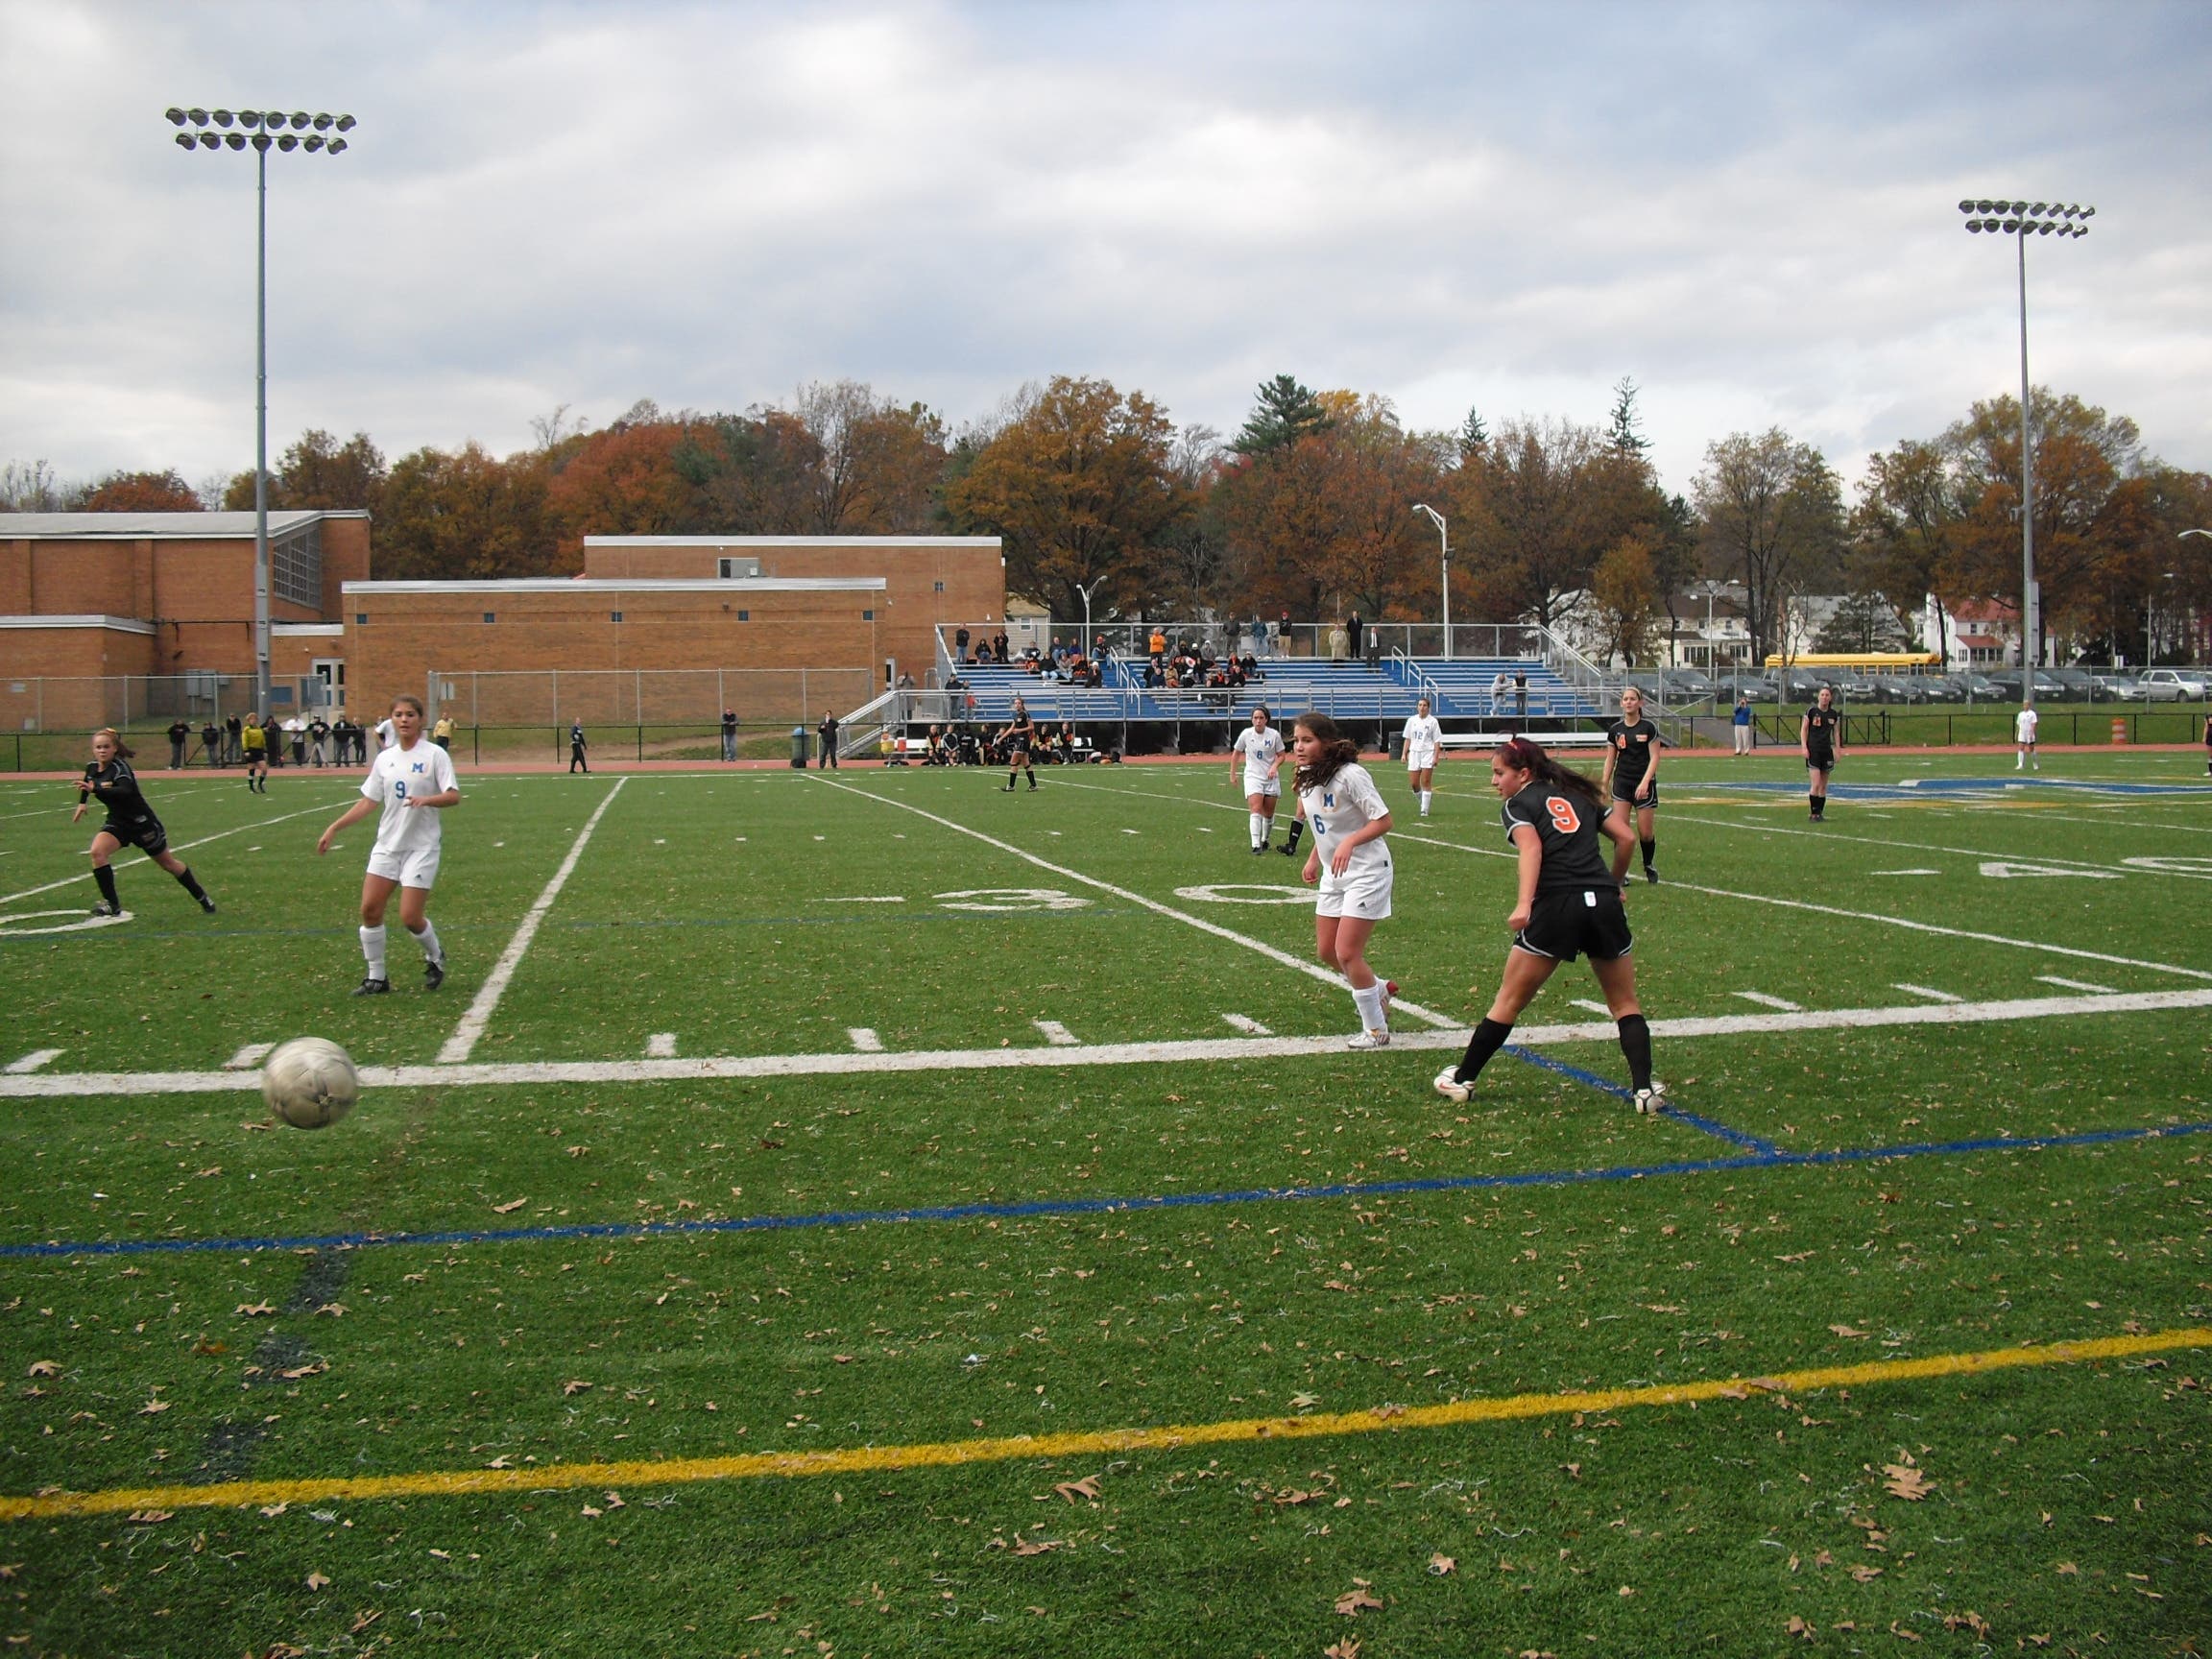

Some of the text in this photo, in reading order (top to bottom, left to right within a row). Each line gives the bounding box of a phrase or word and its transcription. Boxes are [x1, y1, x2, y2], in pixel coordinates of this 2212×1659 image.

[412, 762, 423, 773] M
[396, 781, 405, 799] 9
[1323, 793, 1334, 807] M
[1313, 813, 1325, 834] 6
[1546, 796, 1581, 833] 9
